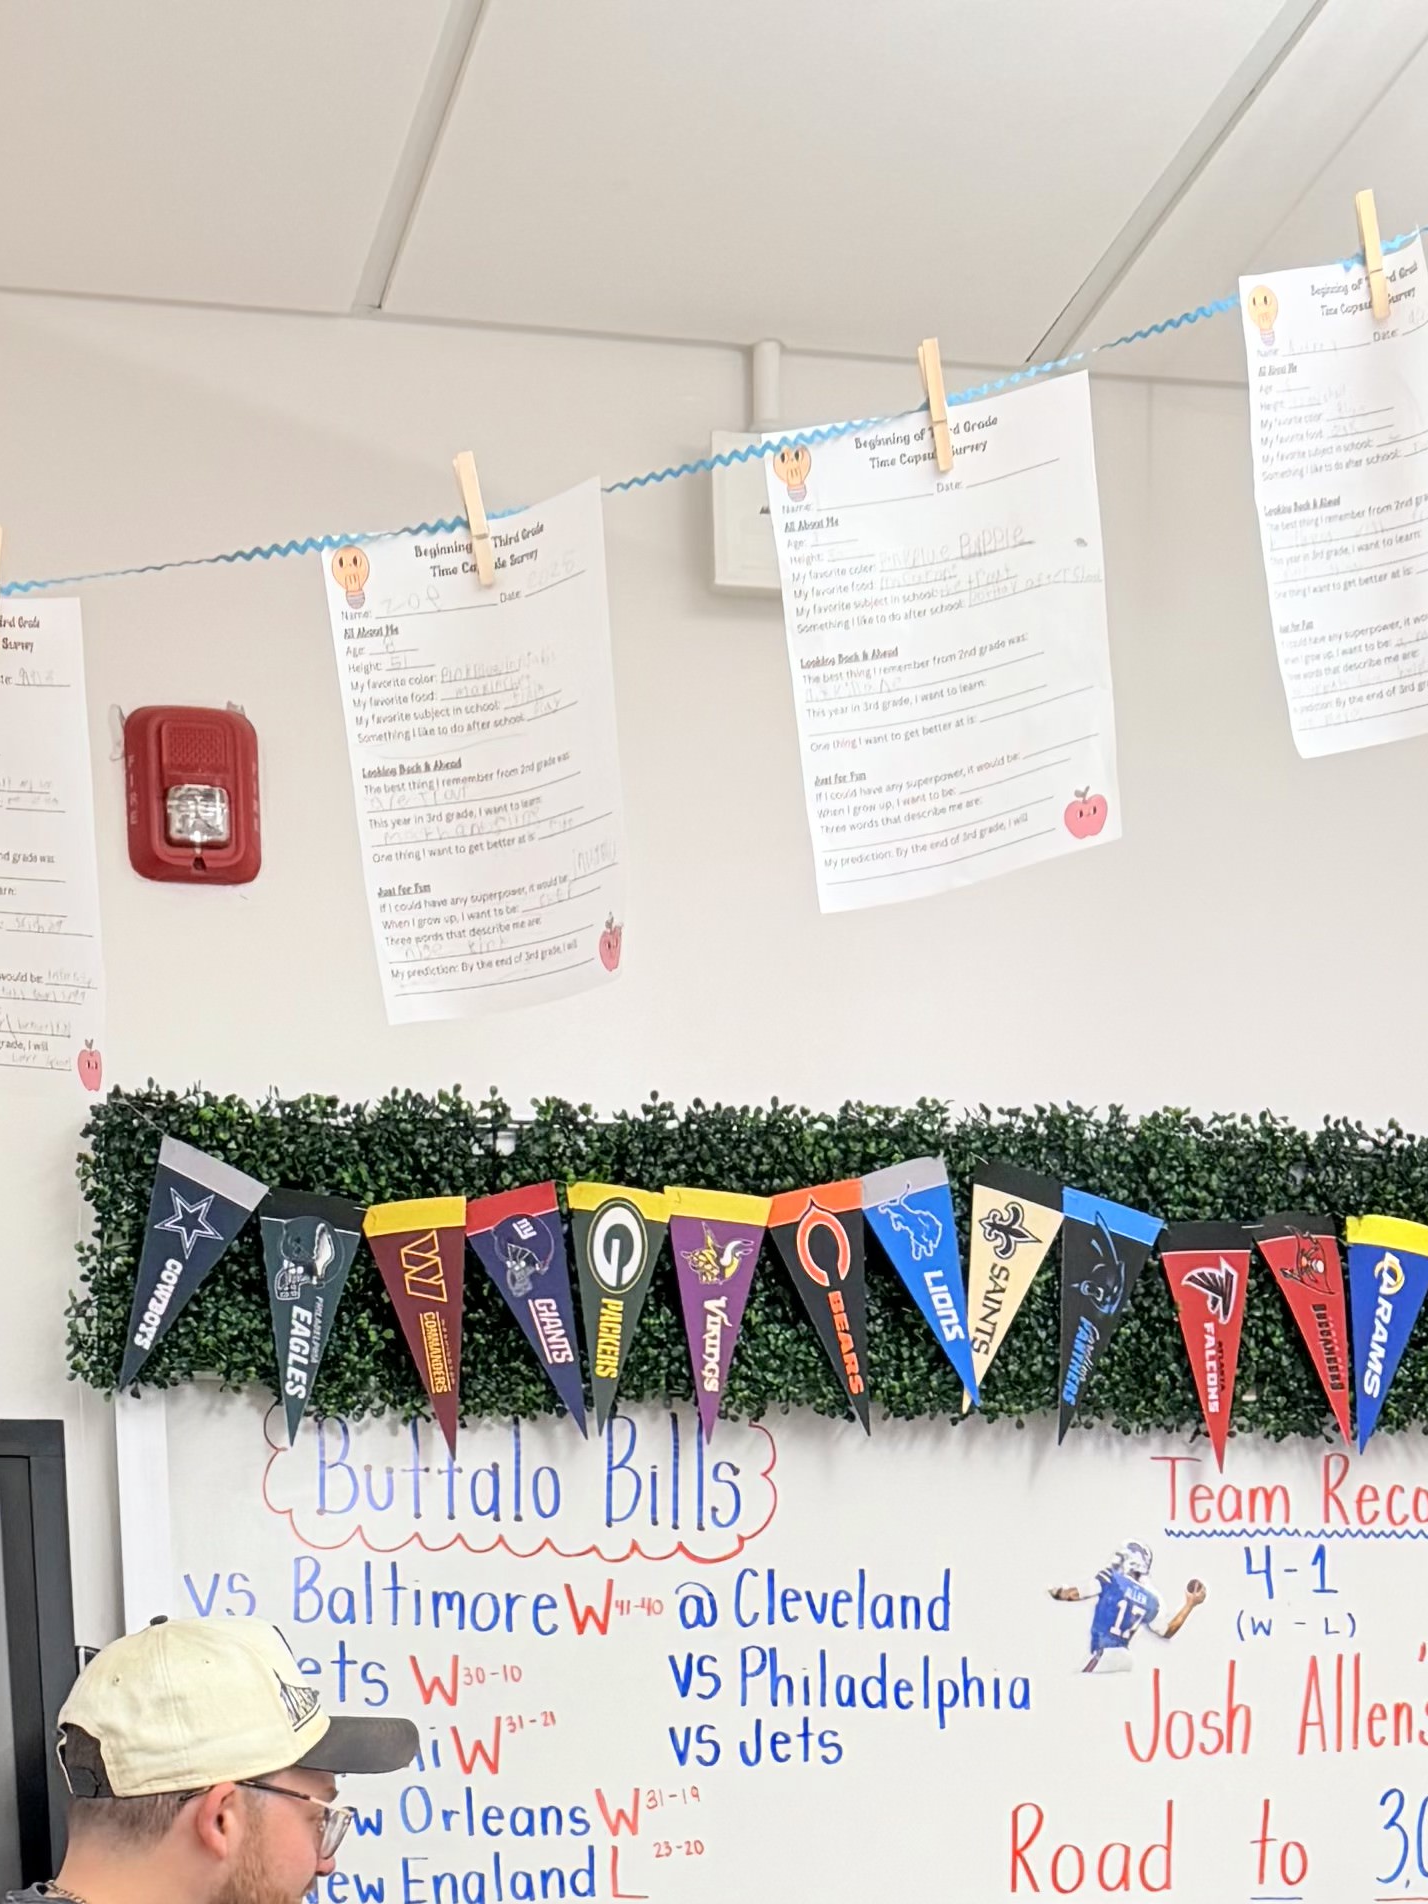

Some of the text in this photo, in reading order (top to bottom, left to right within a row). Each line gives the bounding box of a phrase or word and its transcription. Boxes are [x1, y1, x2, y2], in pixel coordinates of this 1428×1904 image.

[132, 1257, 184, 1352] COWBOYS
[533, 1297, 575, 1366] GIANTS
[595, 1298, 624, 1380] PACKERS
[827, 1290, 864, 1396] BEARS
[923, 1268, 966, 1344] LIONS
[971, 1262, 1011, 1357] SAINTS
[285, 1304, 313, 1400] EAGLES
[422, 1310, 449, 1395] COMMANDERS
[1203, 1320, 1220, 1414] FALCONS
[1363, 1296, 1394, 1400] RAMS
[606, 1412, 742, 1532] Bills
[1149, 1454, 1291, 1525] Team
[183, 1554, 614, 1637] vs Baltimore W
[674, 1567, 952, 1630] @ Cleveland
[1109, 1598, 1148, 1640] 17
[409, 1653, 523, 1707] W 30-10
[668, 1645, 1032, 1729] vs Philadelphia
[1124, 1657, 1253, 1764] Josh
[451, 1714, 503, 1776] W
[668, 1716, 844, 1767] vs Jets
[399, 1784, 592, 1840] Orleans
[594, 1786, 642, 1837] W
[645, 1785, 702, 1813] 31-19
[1009, 1798, 1174, 1894] Road
[1250, 1797, 1310, 1886] to
[609, 1844, 650, 1900] L
[652, 1839, 705, 1861] 23-20
